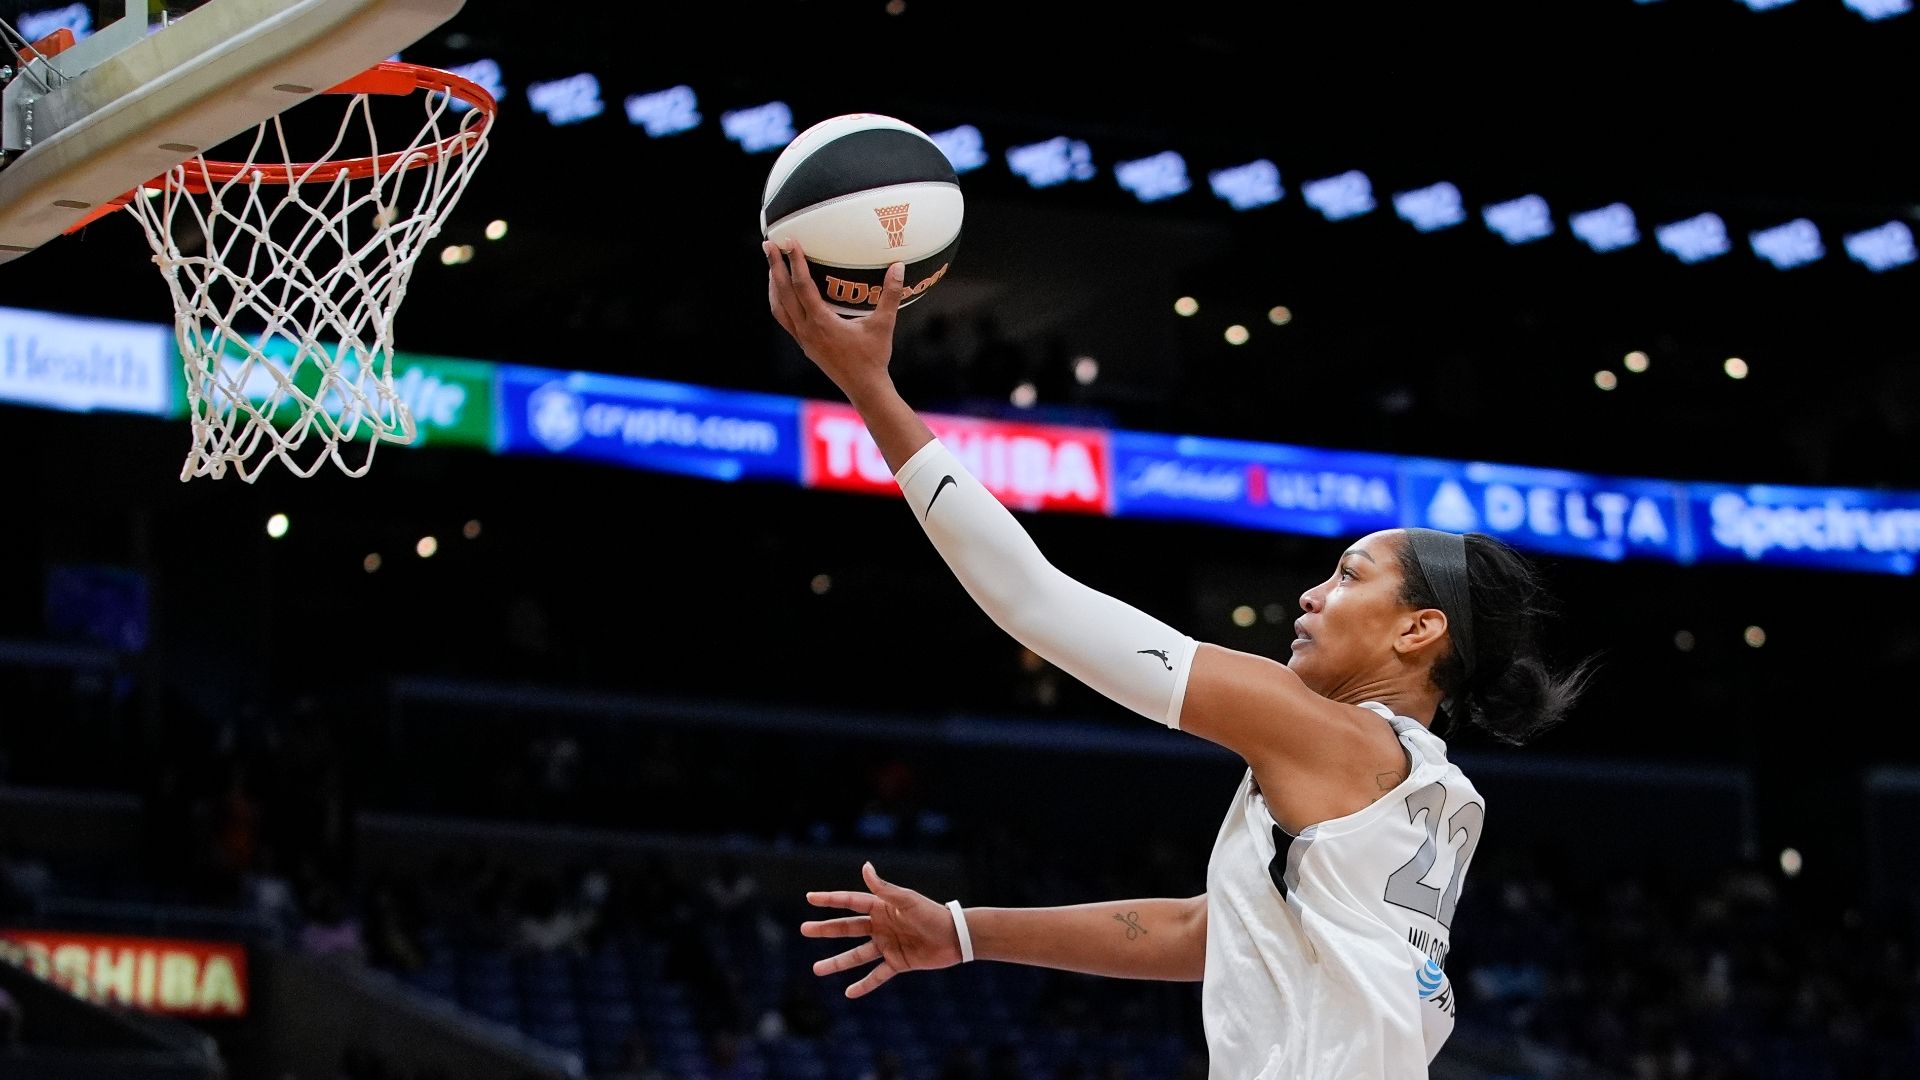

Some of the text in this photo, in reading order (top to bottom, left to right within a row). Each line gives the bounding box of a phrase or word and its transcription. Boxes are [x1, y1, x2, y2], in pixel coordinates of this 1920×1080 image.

[825, 262, 949, 306] Wison
[5, 333, 150, 391] Health
[584, 403, 778, 456] crypto.com
[1268, 470, 1394, 515] ULTRA
[1483, 484, 1670, 545] DELTA
[1384, 781, 1484, 931] 22
[0, 939, 245, 1014] OSHIBA
